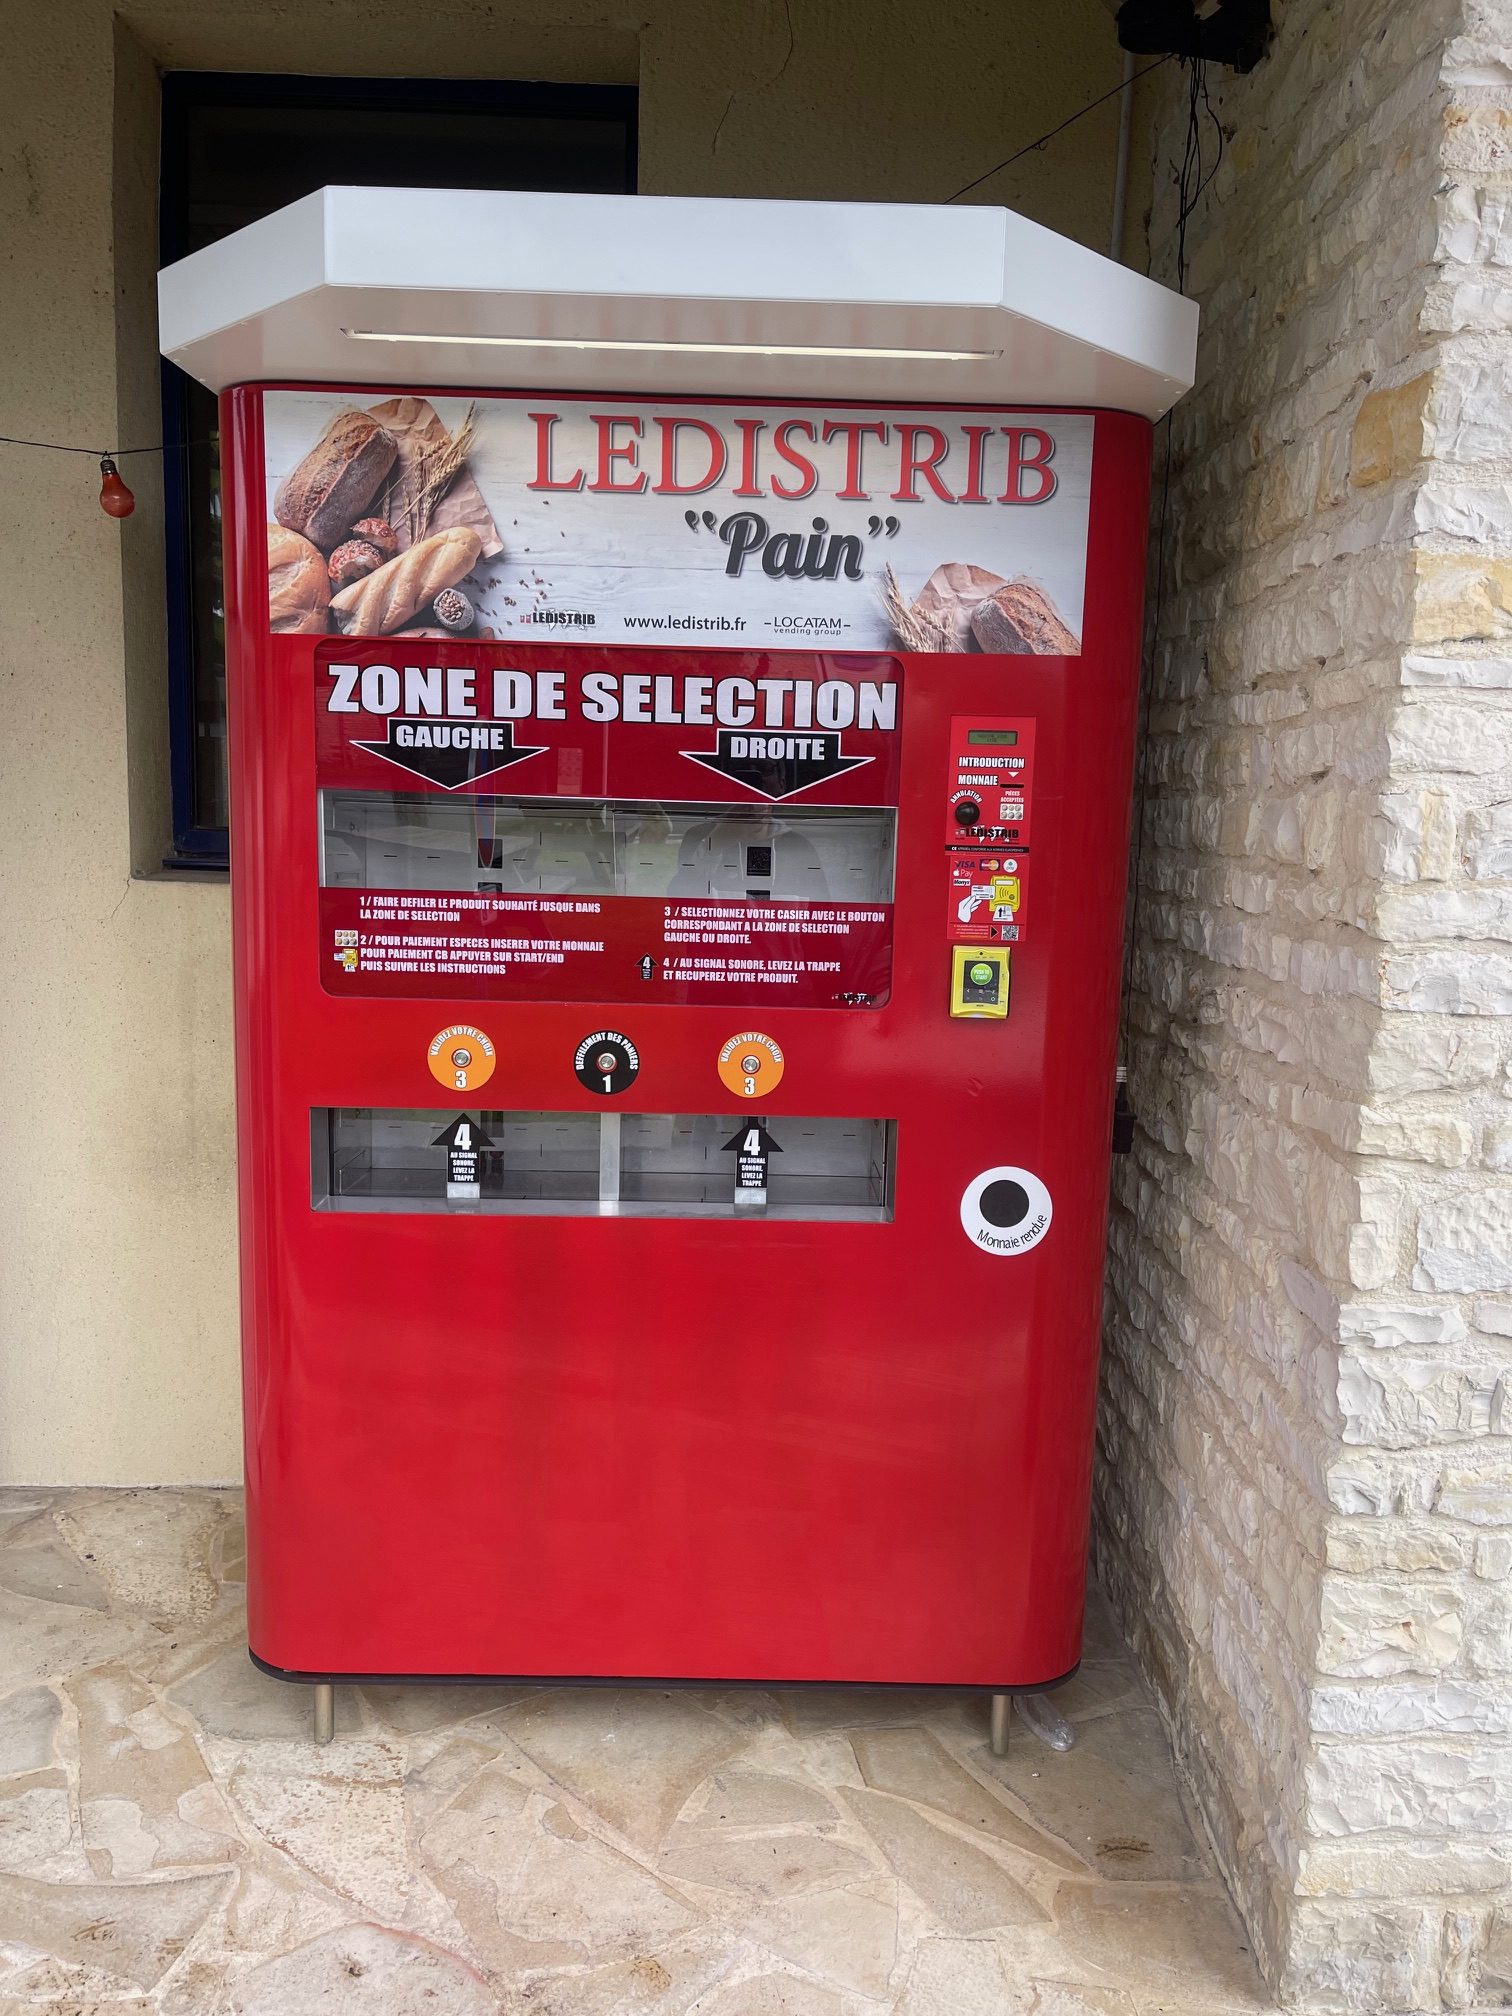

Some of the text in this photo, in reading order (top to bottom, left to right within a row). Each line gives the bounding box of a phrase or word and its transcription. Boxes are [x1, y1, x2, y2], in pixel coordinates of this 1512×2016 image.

[526, 413, 1058, 504] LEDISTRIB
[532, 611, 595, 625] LEDISTRIB
[623, 615, 747, 631] www.ledistrib.fr
[774, 627, 811, 635] vending
[327, 664, 897, 730] ZONE DE SELECTION
[396, 725, 504, 750] GAUCHE
[729, 737, 826, 761] DROITE
[959, 757, 1025, 768] INTRODUCTION
[958, 775, 998, 785] MONNAIE
[950, 790, 983, 803] ANNULATION
[961, 869, 973, 878] Pay
[360, 896, 600, 913] 1 / FAIRE DEFILER LE PRODUIT SOUHAITÉ JUSQUE DANS
[360, 910, 460, 922] LA ZONE DE SELECTION
[664, 907, 885, 922] 3 / SELECTIONNEZ VOTRE CASIER AVEC LE BOUTON
[664, 920, 849, 934] CORRESPONDANT A LA ZONE DE SELECTION
[361, 935, 604, 951] 2 / POUR PAIEMENT ESPECES INSERER VOTRE MONNAIE
[664, 933, 751, 944] GAUCHE OU DROITE.
[361, 948, 564, 963] POUR PAIEMENT CB APPUYER SUR START/END
[643, 957, 650, 968] 4
[361, 962, 506, 974] PUIS SUIVRE LES INSTRUCTIONS
[663, 958, 840, 972] 4 / AU SIGNAL SONORE, LEVEZ LA TRAPPE
[664, 971, 798, 983] ET RECUPEREZ VOTRE PRODUIT.
[430, 1026, 494, 1057] VALIDEZ VOTRE CHOIX
[720, 1034, 782, 1063] VALIDEZ VOTRE CHOIX
[575, 1032, 639, 1070] DEFFILEMENT DES PANIERS
[455, 1070, 467, 1088] 3
[602, 1075, 611, 1092] 1
[744, 1077, 755, 1095] 3
[454, 1124, 472, 1150] 4
[743, 1129, 760, 1155] 4
[977, 1215, 1047, 1249] Monnaie rendue
